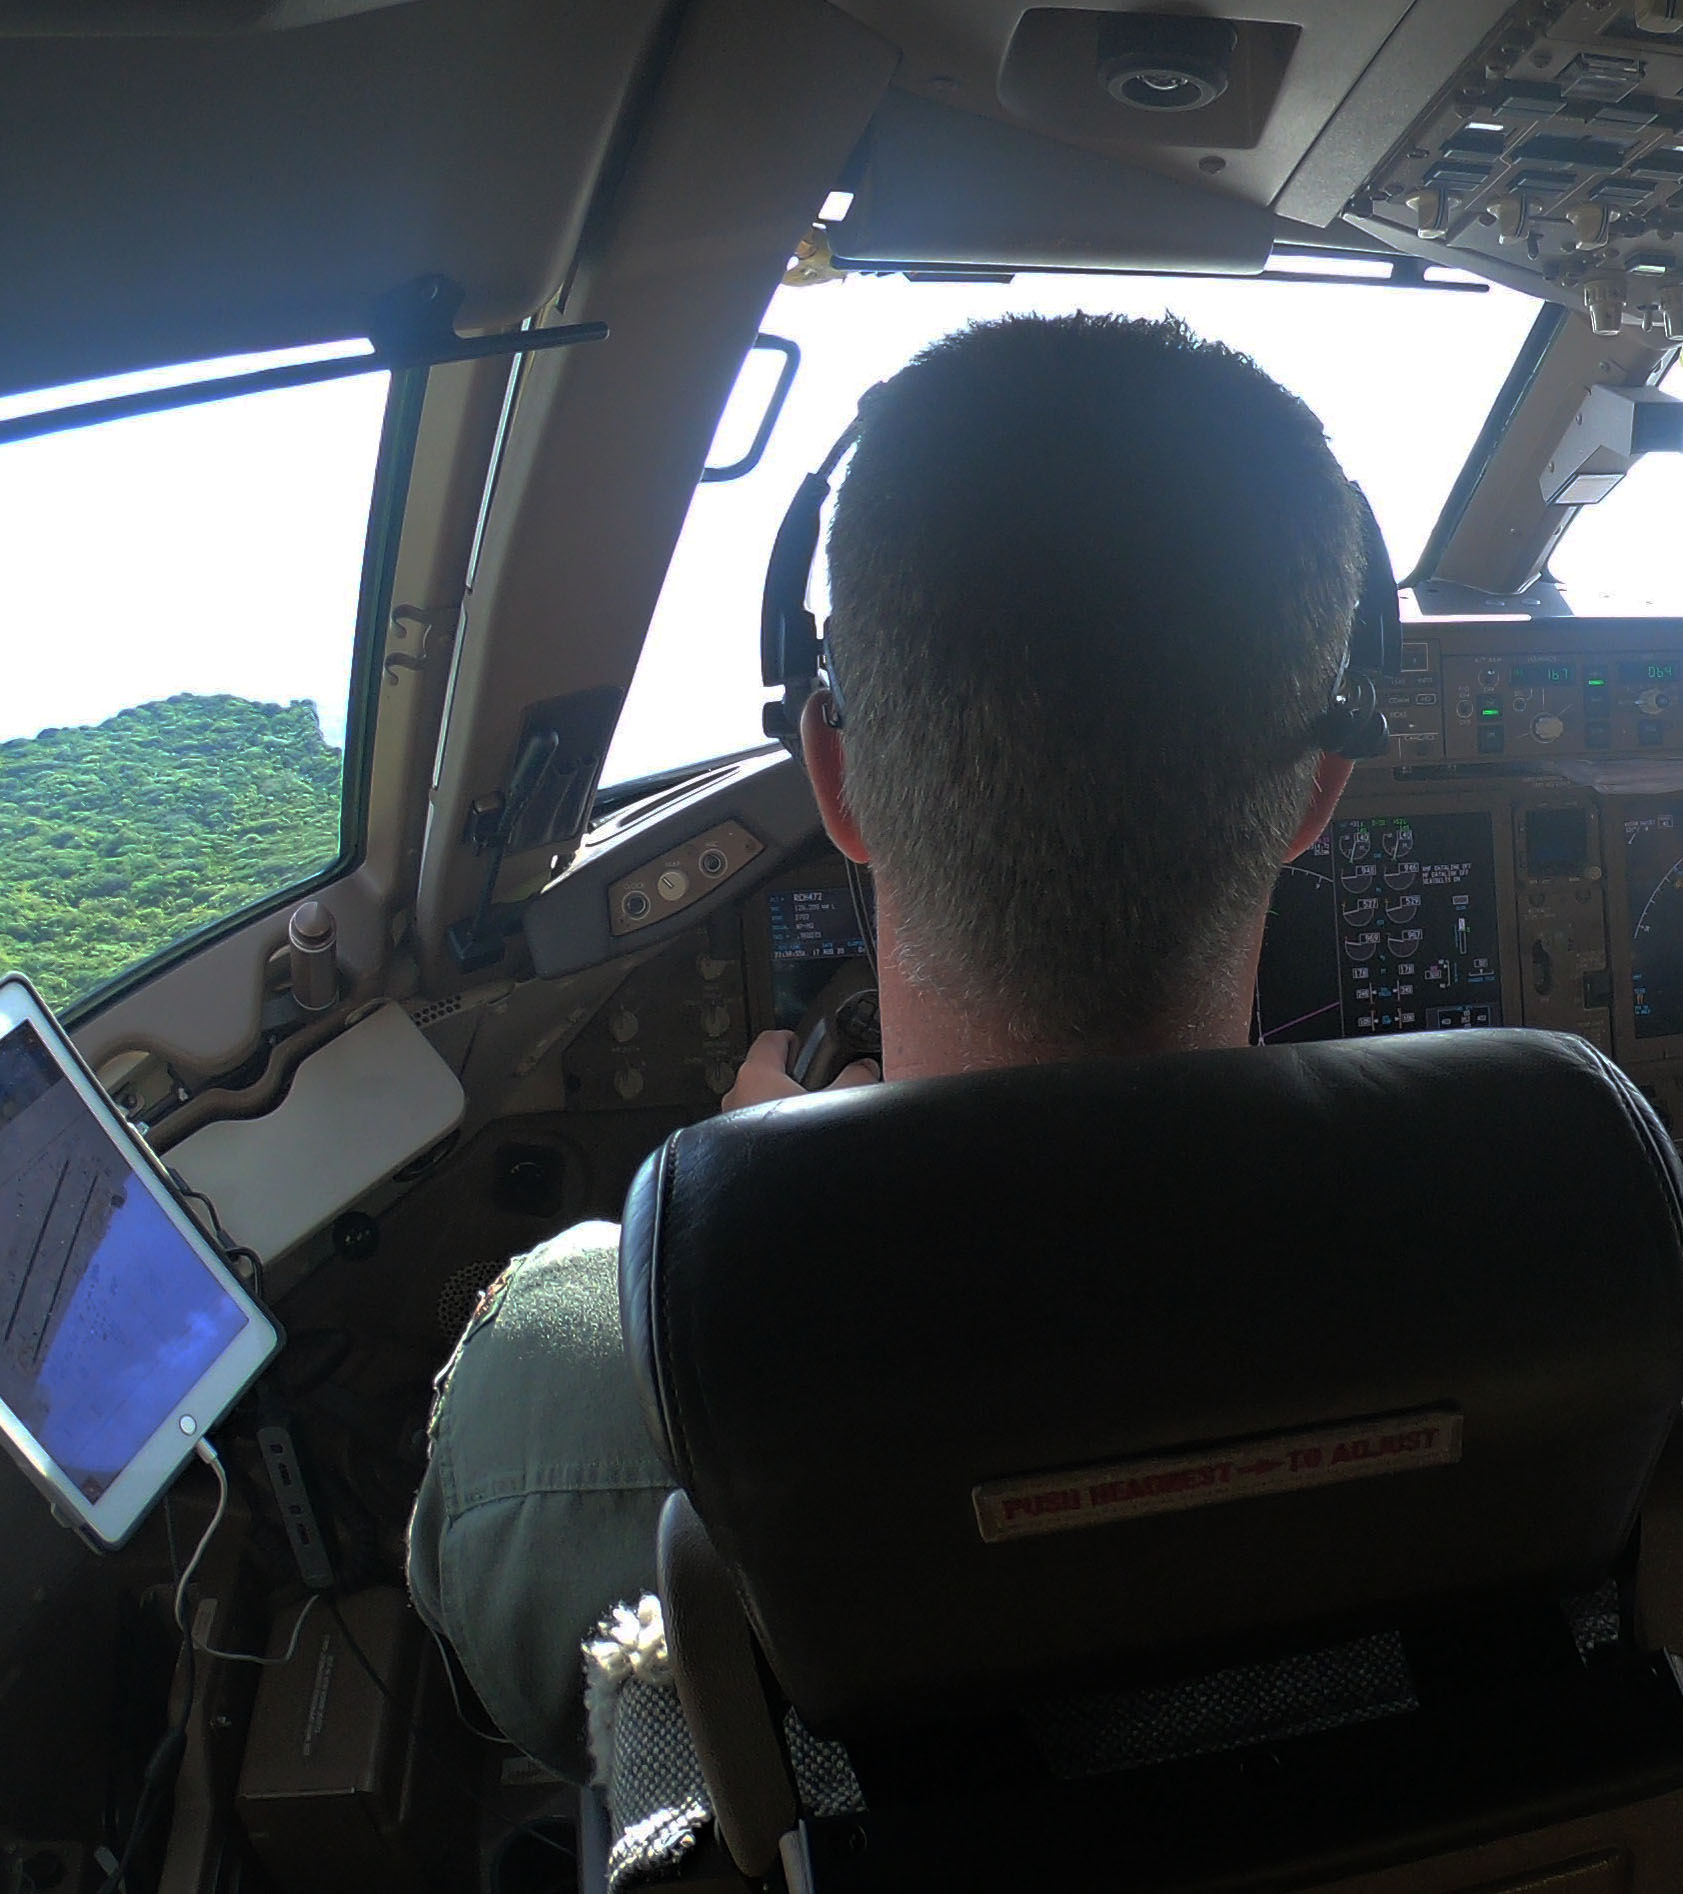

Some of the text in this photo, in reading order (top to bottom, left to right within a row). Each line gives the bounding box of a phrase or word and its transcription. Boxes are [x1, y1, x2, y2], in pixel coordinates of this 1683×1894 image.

[1002, 1489, 1081, 1521] PUSH
[1288, 1447, 1323, 1473] TO
[1331, 1427, 1441, 1467] ADJUST
